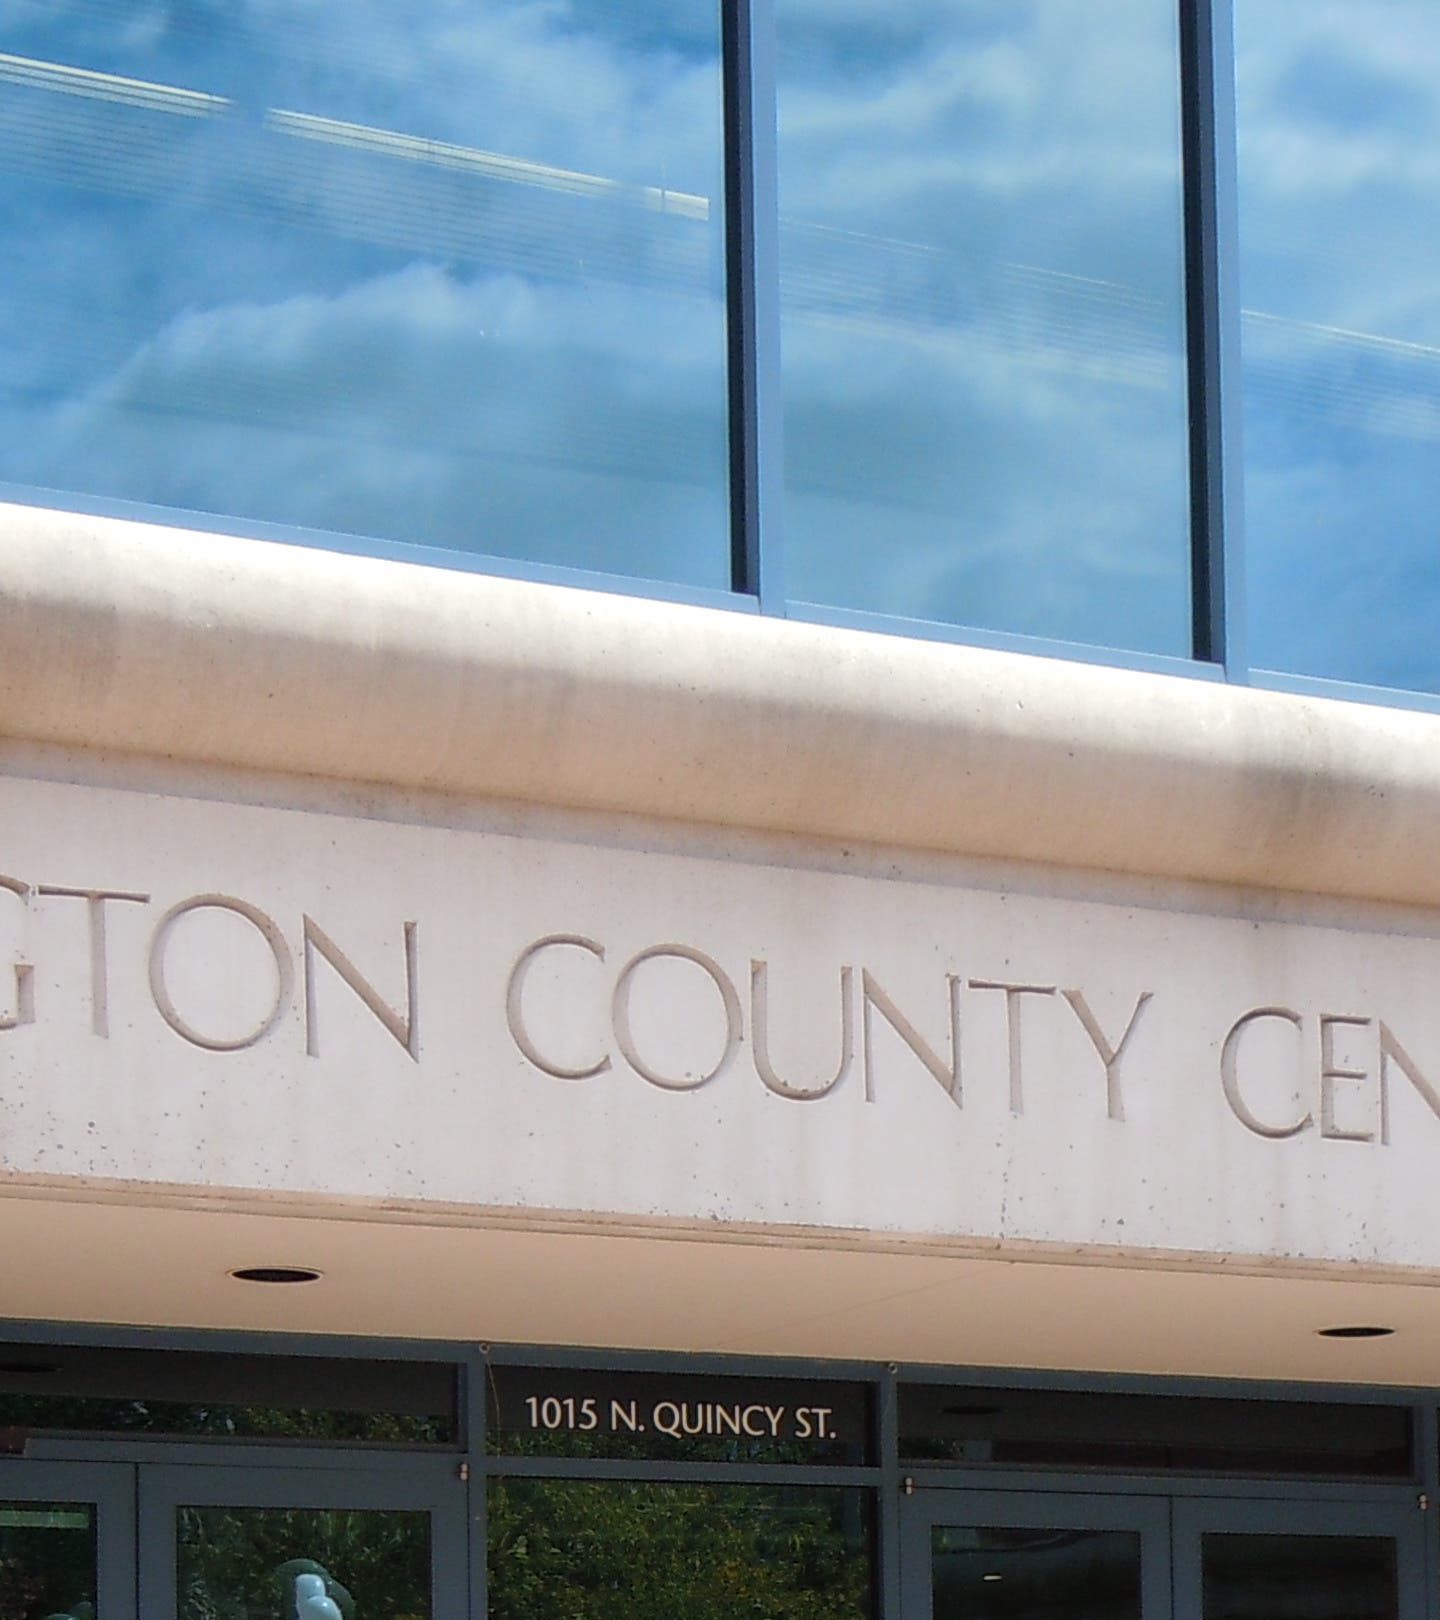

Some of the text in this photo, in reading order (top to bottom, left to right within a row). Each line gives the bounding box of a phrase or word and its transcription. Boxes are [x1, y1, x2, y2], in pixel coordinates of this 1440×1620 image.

[506, 932, 1153, 1124] COUNTY
[525, 1396, 837, 1440] 1015 N. QUINCY ST.
